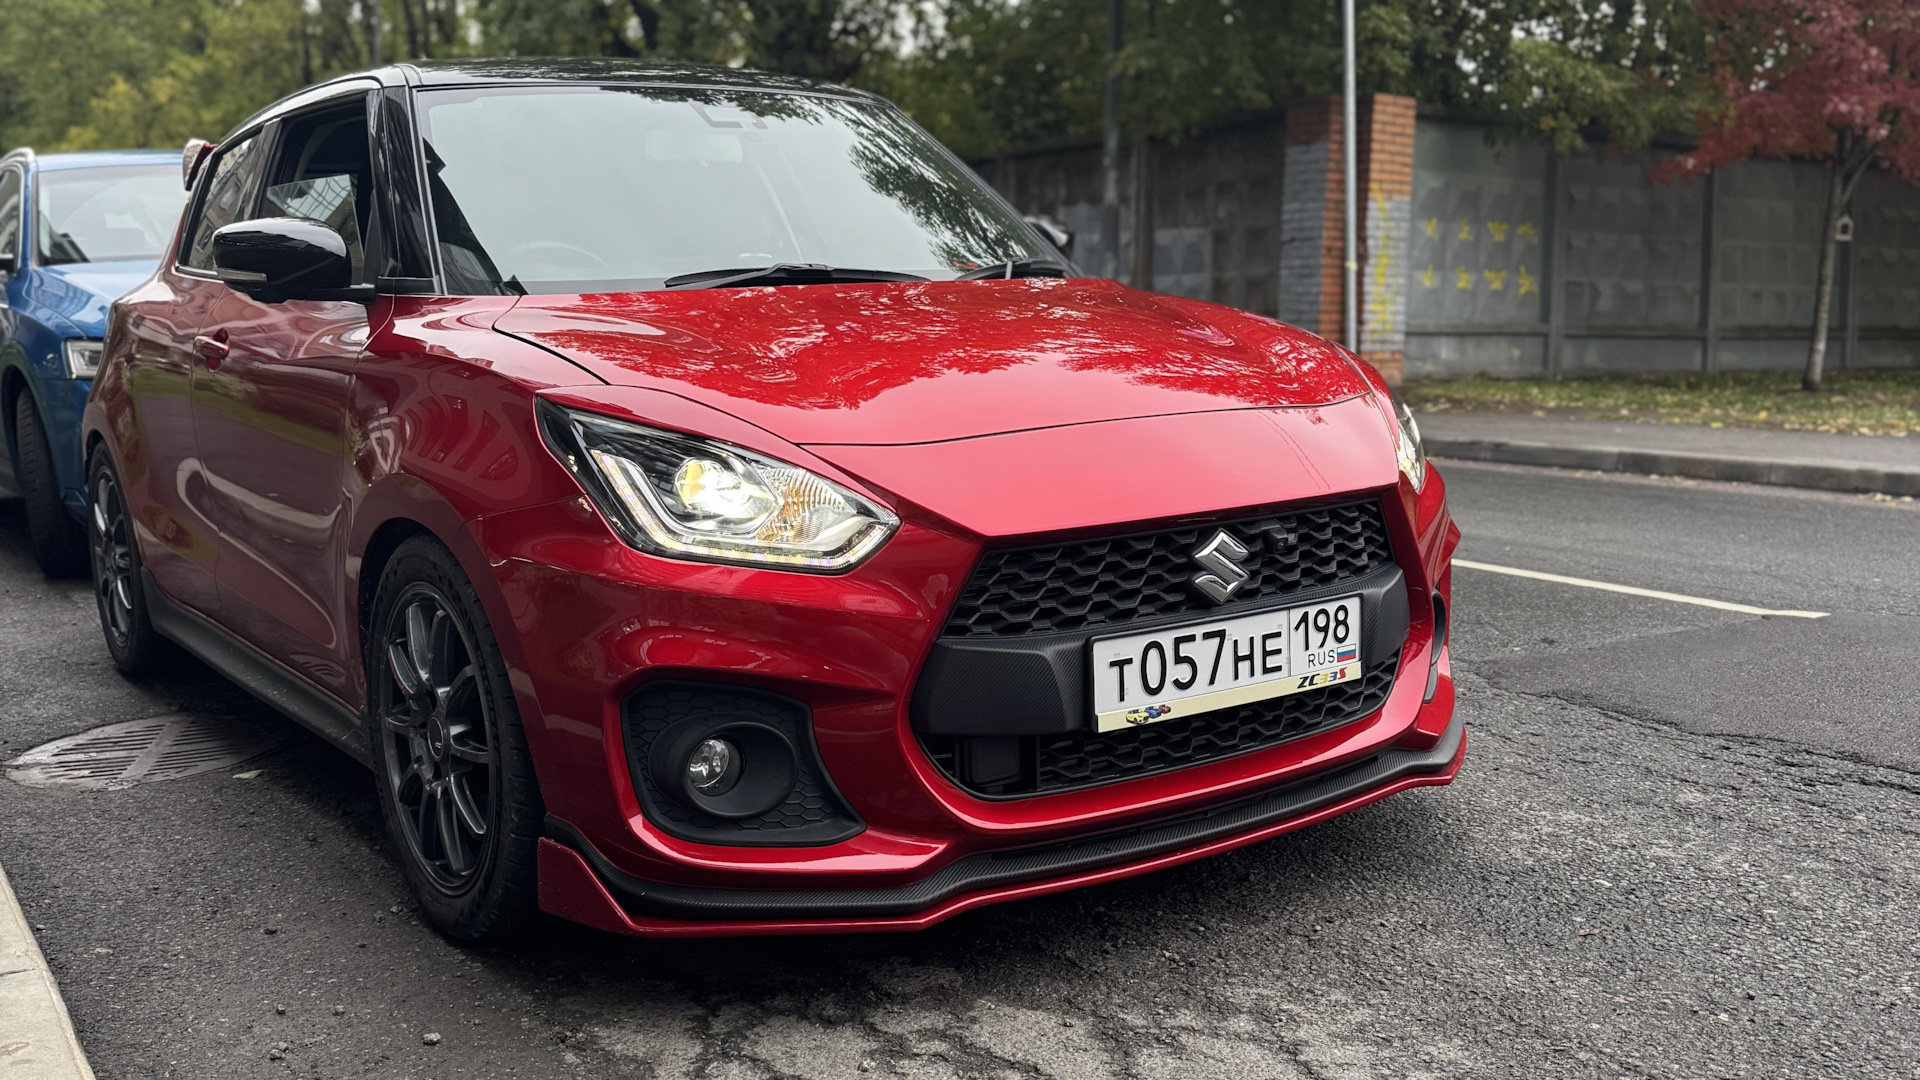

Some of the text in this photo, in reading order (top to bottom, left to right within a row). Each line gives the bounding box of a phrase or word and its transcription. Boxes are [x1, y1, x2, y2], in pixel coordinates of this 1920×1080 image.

[1294, 604, 1350, 651] 198
[1308, 649, 1336, 669] RUS
[1296, 666, 1348, 690] ZC33S
